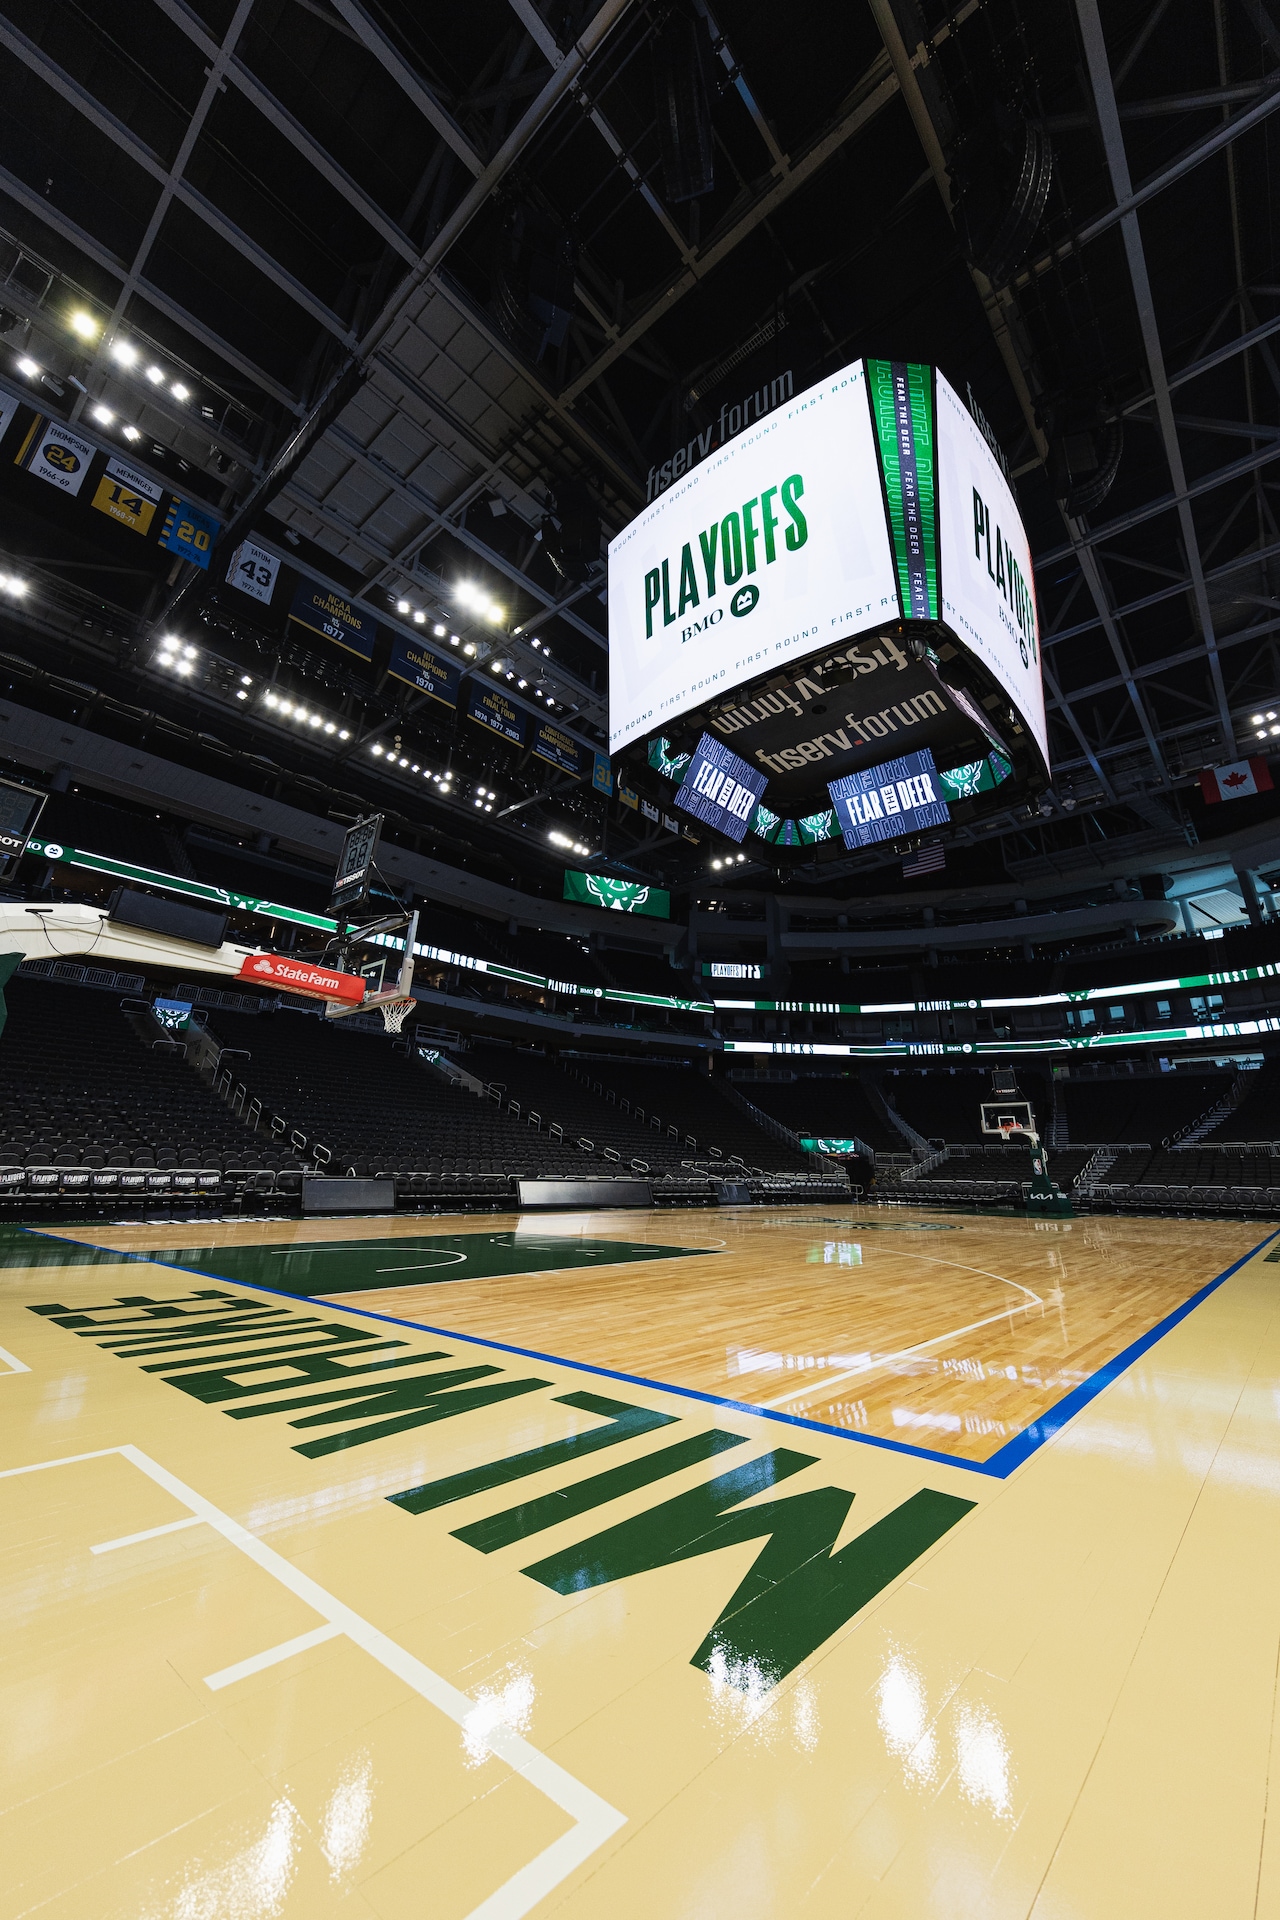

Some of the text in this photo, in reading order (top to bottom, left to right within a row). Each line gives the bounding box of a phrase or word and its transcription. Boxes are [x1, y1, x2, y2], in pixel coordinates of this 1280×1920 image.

[896, 377, 908, 402] FEAR
[898, 405, 909, 426] THE
[50, 427, 91, 456] THOMPSON
[900, 429, 911, 456] DEER
[46, 445, 77, 473] 24
[642, 503, 666, 527] FIRST
[669, 476, 700, 504] ROUND
[788, 393, 825, 420] FIRST
[39, 465, 71, 487] 1966-69
[115, 467, 155, 494] MEMINGER
[905, 471, 915, 498] FEAR
[108, 484, 143, 517] 14
[907, 502, 917, 522] THE
[109, 504, 136, 526] 1968-71
[177, 520, 212, 552] 20
[909, 527, 920, 555] DEER
[250, 548, 271, 565] TATUM
[644, 473, 809, 640] PLAYOFFS
[239, 560, 272, 588] 43
[913, 572, 924, 601] FEAR
[312, 594, 362, 630] CHAMPIONS
[327, 593, 351, 614] NCAA
[322, 622, 345, 642] 1977
[681, 608, 724, 644] BMO
[406, 650, 448, 681] CHAMPIONS
[422, 650, 436, 664] NIT
[625, 710, 654, 732] ROUND
[660, 689, 687, 710] FIRST
[691, 669, 727, 693] ROUND
[735, 647, 770, 670] FIRST
[775, 625, 820, 651] ROUND
[831, 603, 873, 627] FIRST
[415, 675, 435, 692] 1970
[473, 709, 488, 723] 1974
[490, 718, 504, 731] 1977
[482, 696, 500, 713] FINAL
[500, 707, 516, 722] FOUR
[596, 764, 612, 788] 31
[692, 759, 756, 822] FEAR THE DEER
[846, 772, 938, 827] FEAR THE DEER
[343, 869, 366, 885] TISSOT
[713, 964, 740, 977] PLAYOFFS
[1208, 969, 1249, 986] FIRST
[548, 979, 578, 995] PLAYOFFS
[775, 1001, 840, 1013] FIRST ROUND
[918, 1000, 951, 1012] PLAYOFFS
[773, 1043, 814, 1055] BUCKS
[909, 1043, 945, 1056] PLAYOFFS
[25, 1289, 978, 1694] MILWAUKEE
